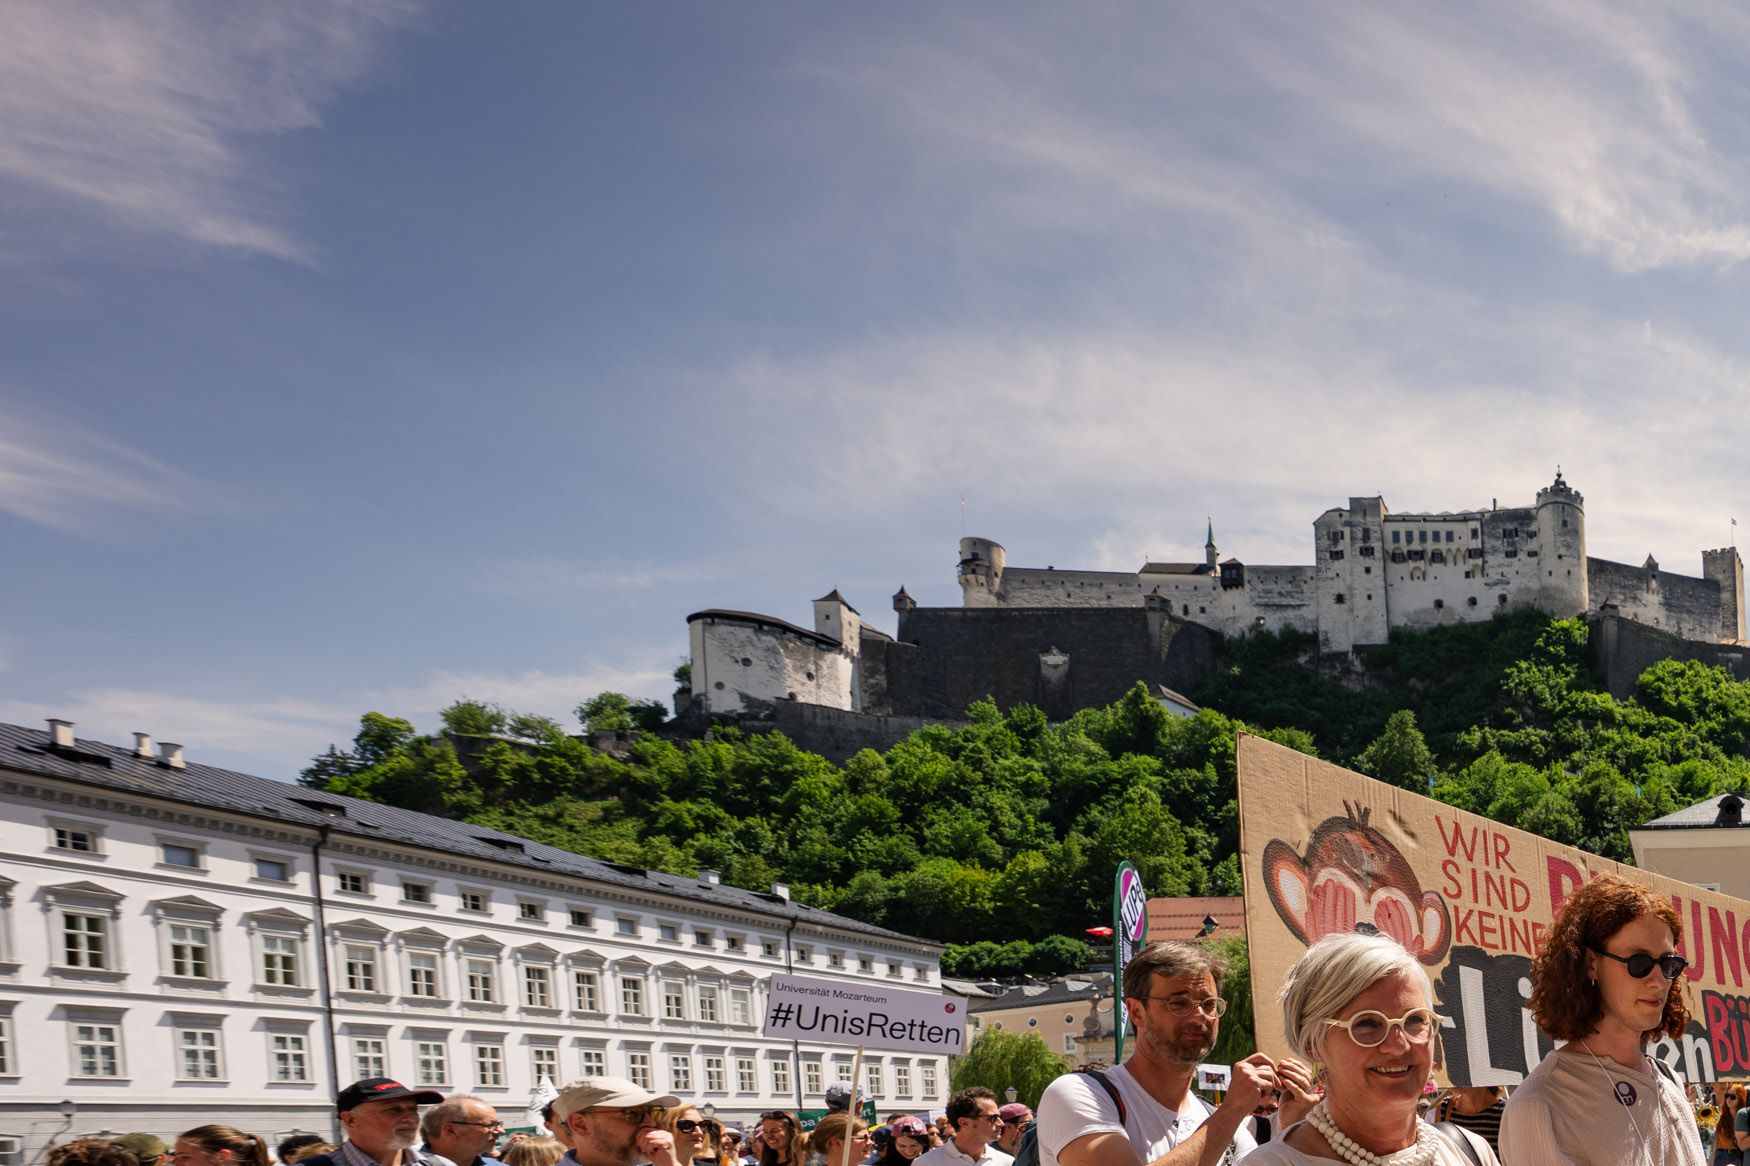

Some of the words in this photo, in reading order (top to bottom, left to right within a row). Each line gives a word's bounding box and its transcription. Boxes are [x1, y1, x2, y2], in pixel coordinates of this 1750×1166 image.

[1435, 815, 1516, 873] WIR
[1441, 859, 1531, 913] SIND
[776, 982, 830, 998] Universität
[832, 989, 888, 1004] Mozarteum
[770, 1002, 961, 1045] #UnisRetten
